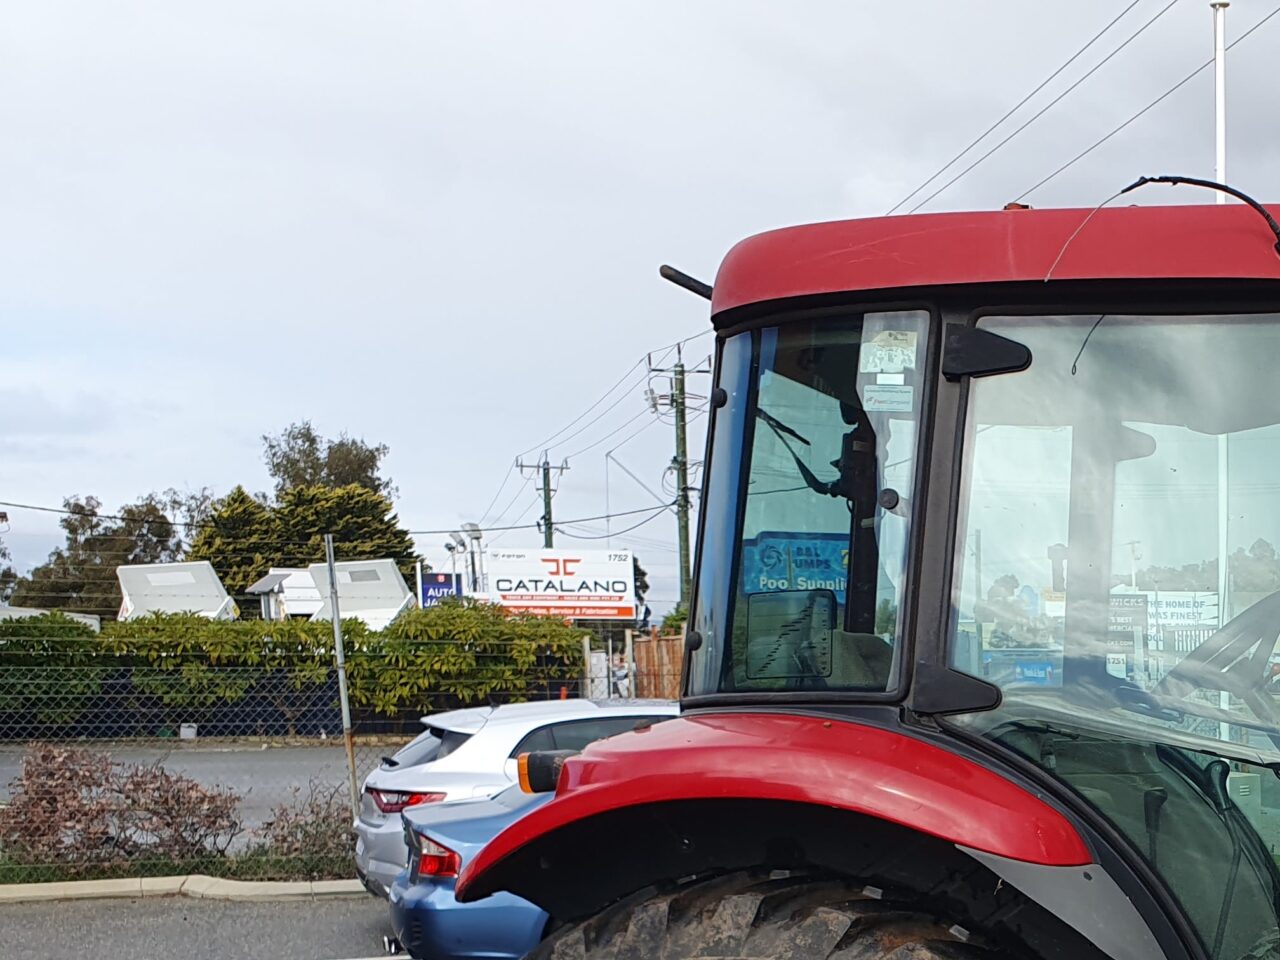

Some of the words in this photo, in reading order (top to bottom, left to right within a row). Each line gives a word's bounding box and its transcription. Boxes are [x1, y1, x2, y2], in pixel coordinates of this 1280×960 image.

[607, 553, 629, 562] 1752
[792, 559, 831, 569] UMPS
[495, 579, 627, 593] CATALANO
[759, 577, 793, 589] Poo
